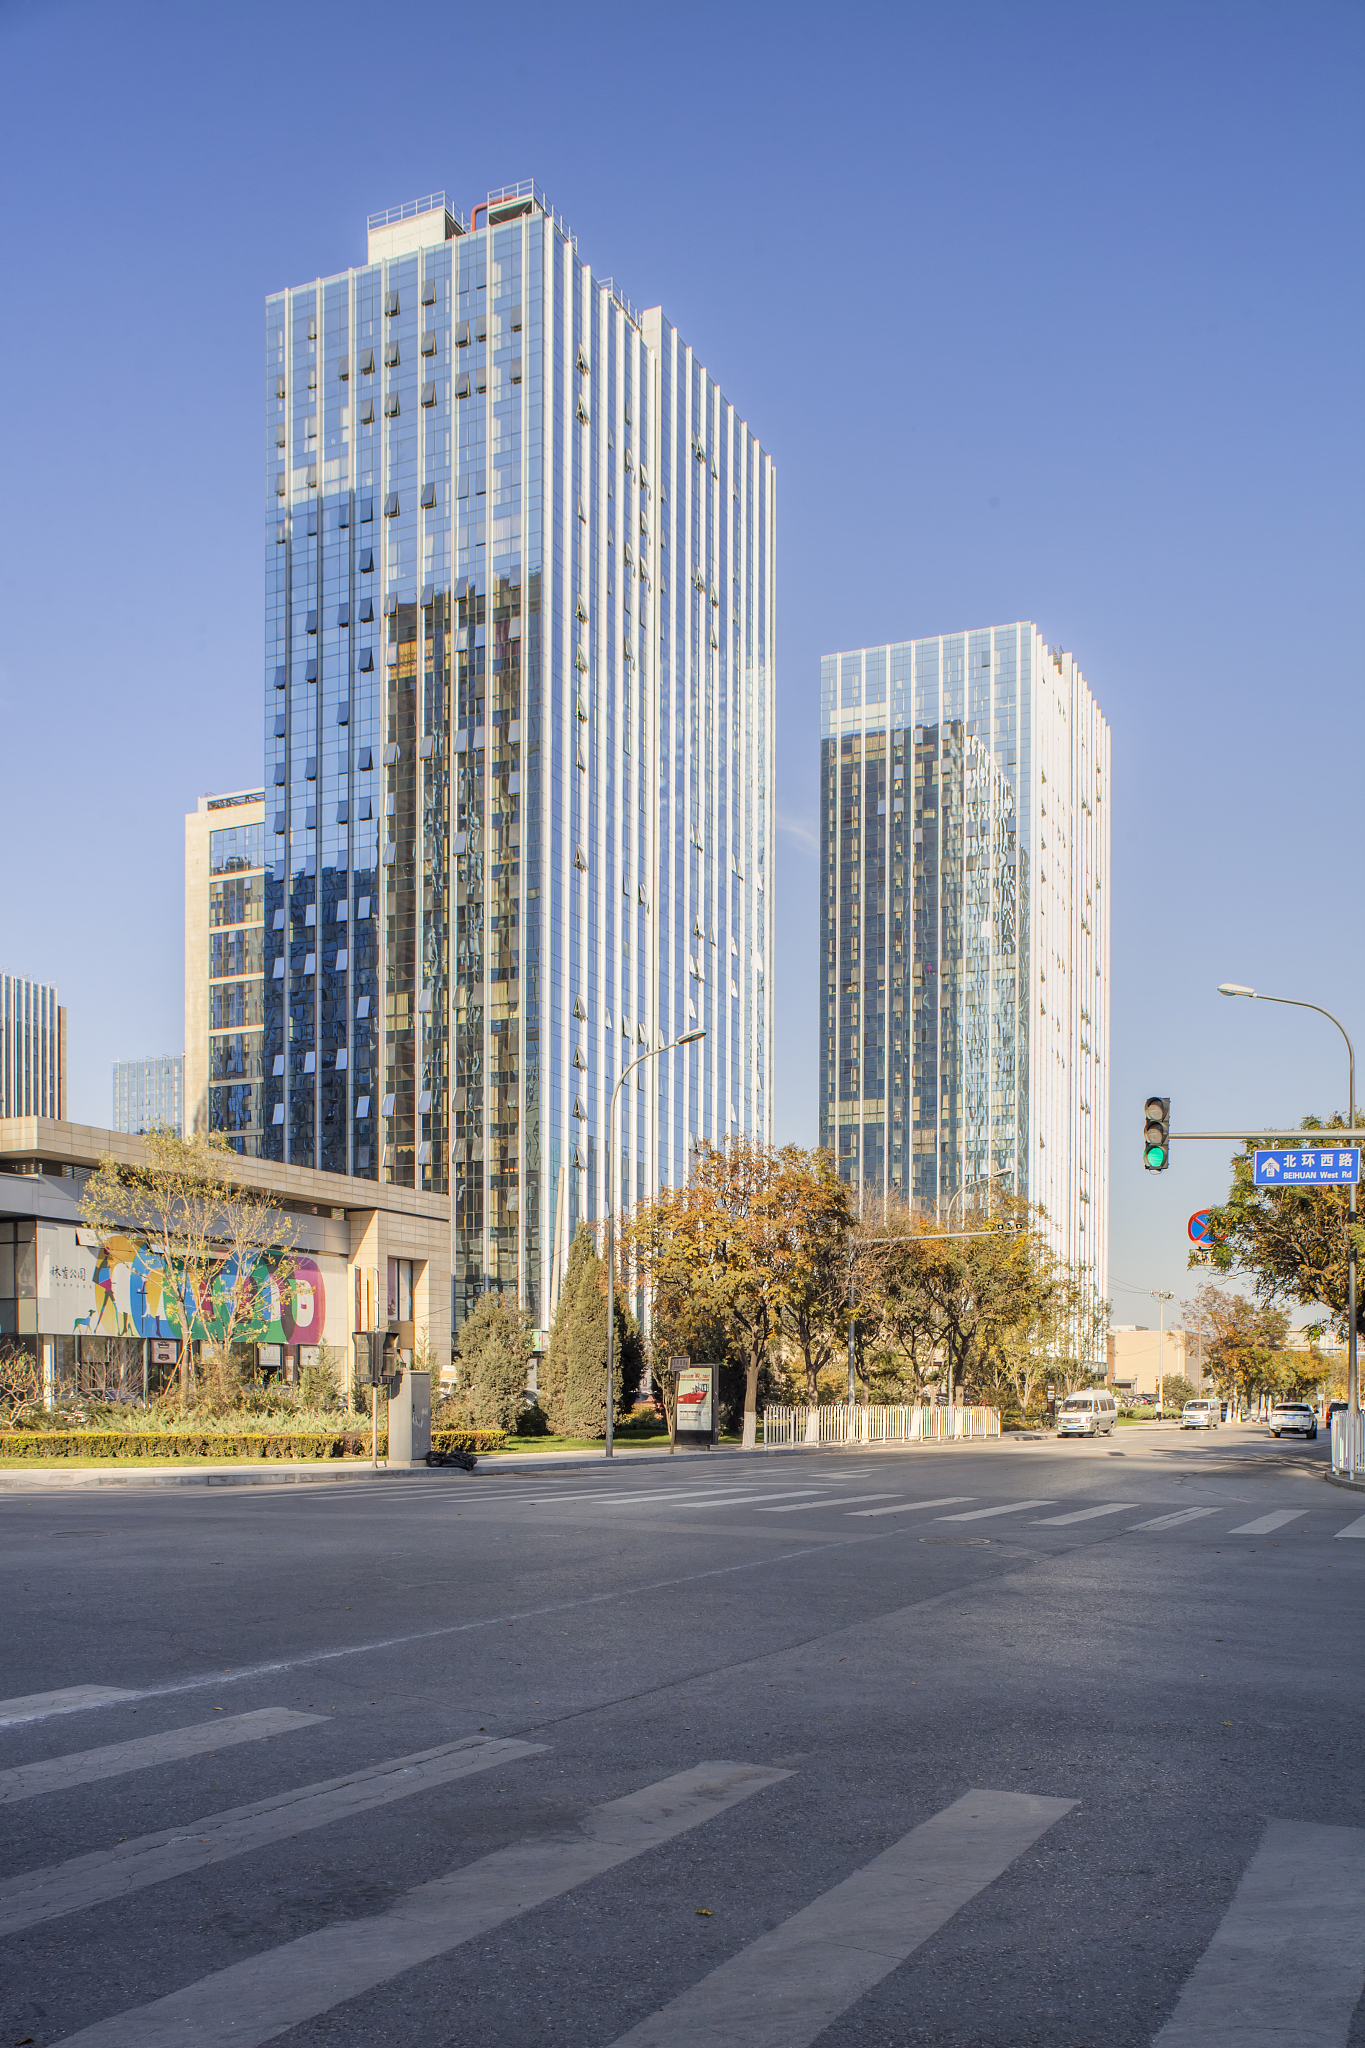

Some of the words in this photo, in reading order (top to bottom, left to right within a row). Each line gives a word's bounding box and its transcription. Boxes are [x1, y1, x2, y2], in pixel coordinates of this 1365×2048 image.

[1283, 1153, 1353, 1168] 北环西路
[1283, 1171, 1317, 1180] BEIHUAN
[1320, 1171, 1339, 1179] West
[1341, 1171, 1352, 1179] Rd
